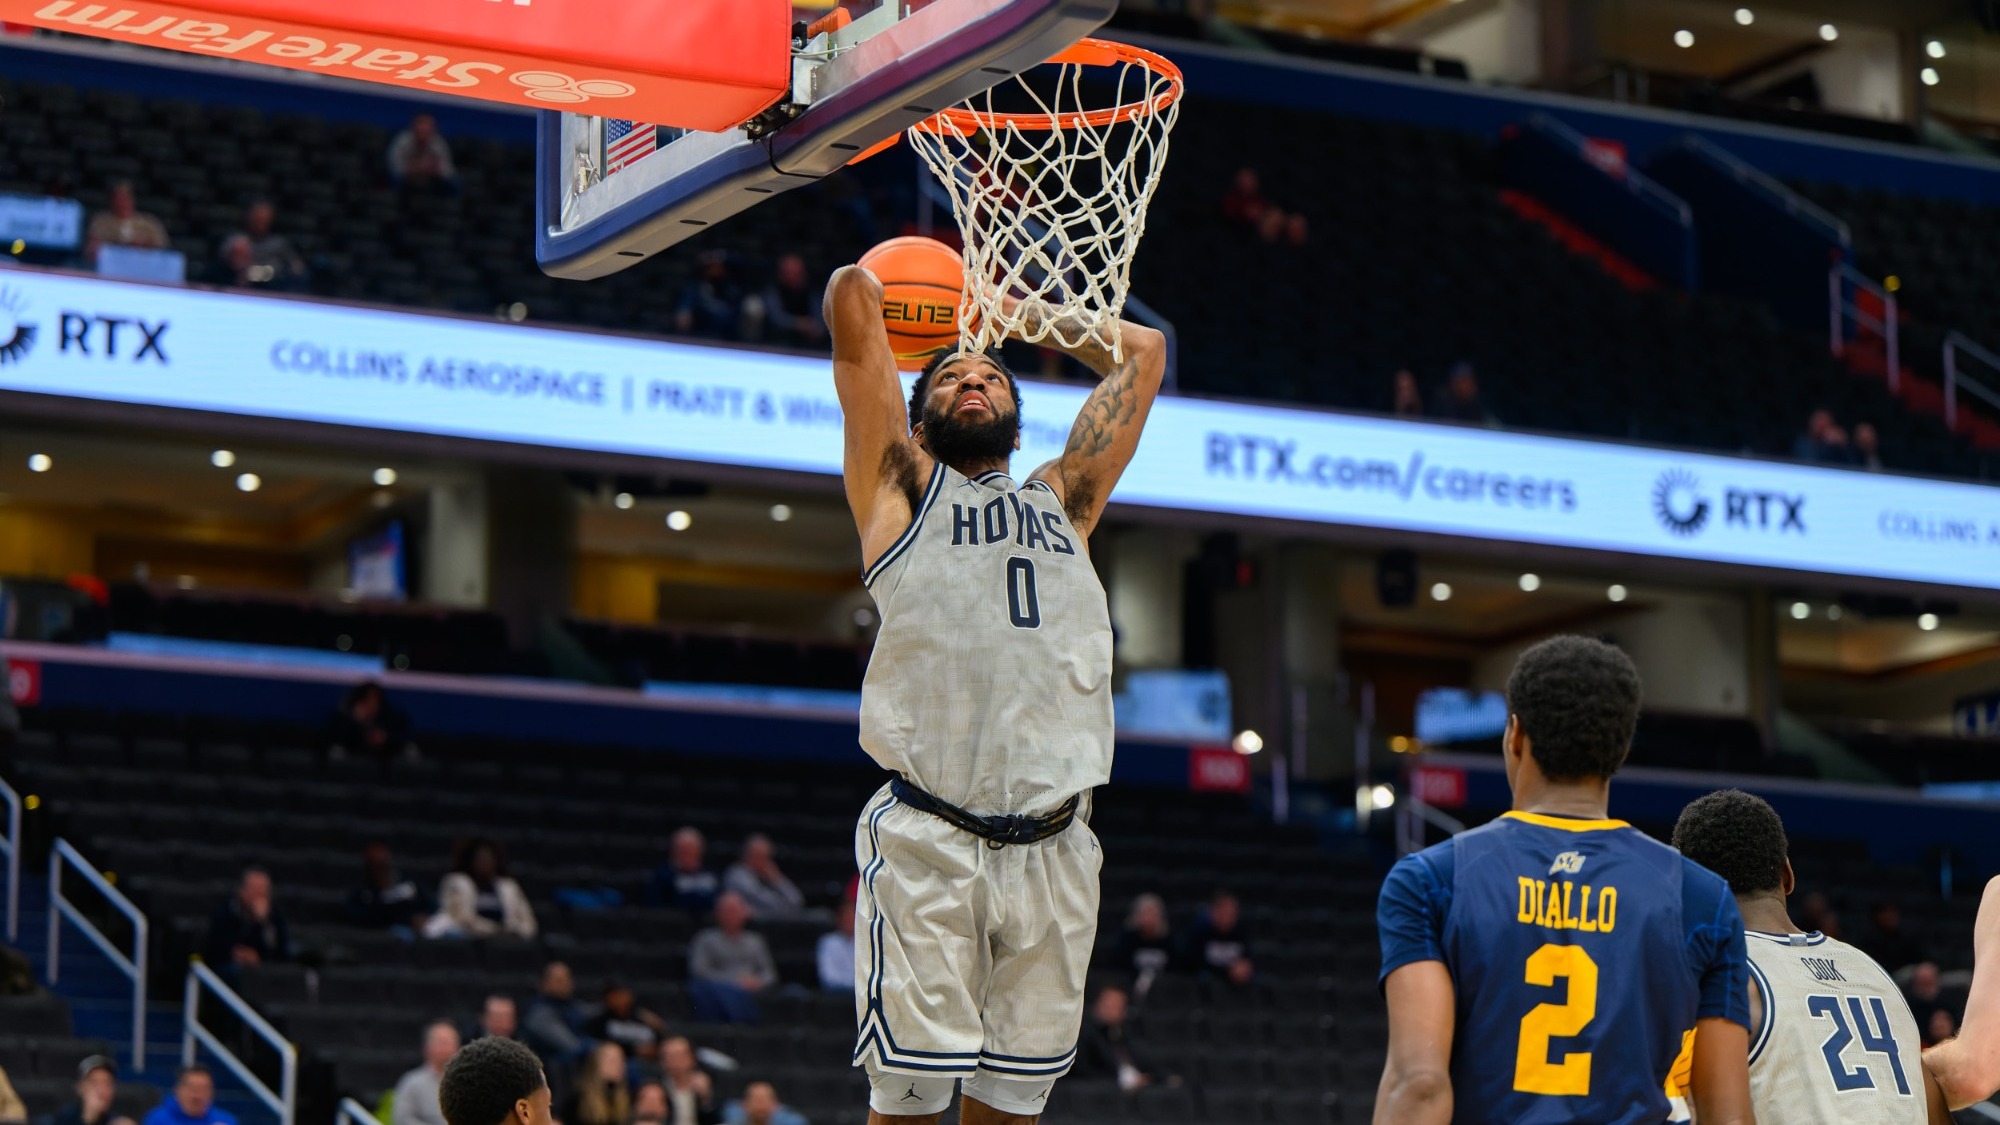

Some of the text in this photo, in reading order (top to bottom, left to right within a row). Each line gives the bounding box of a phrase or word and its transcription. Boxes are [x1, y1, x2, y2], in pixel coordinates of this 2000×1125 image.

[57, 310, 170, 366] RTX
[883, 301, 955, 326] ELITE
[270, 338, 408, 385] COLLINS
[416, 354, 606, 410] AEROSPACE
[645, 378, 745, 422] PRATT
[1204, 430, 1579, 514] RTX.com/careers
[951, 492, 1076, 556] HOYAS
[1722, 487, 1808, 535] RTX
[1006, 556, 1041, 630] 0
[1517, 876, 1617, 933] DIALLO
[1800, 957, 1847, 982] COOK
[1513, 943, 1599, 1096] 2
[1806, 993, 1914, 1098] 24
